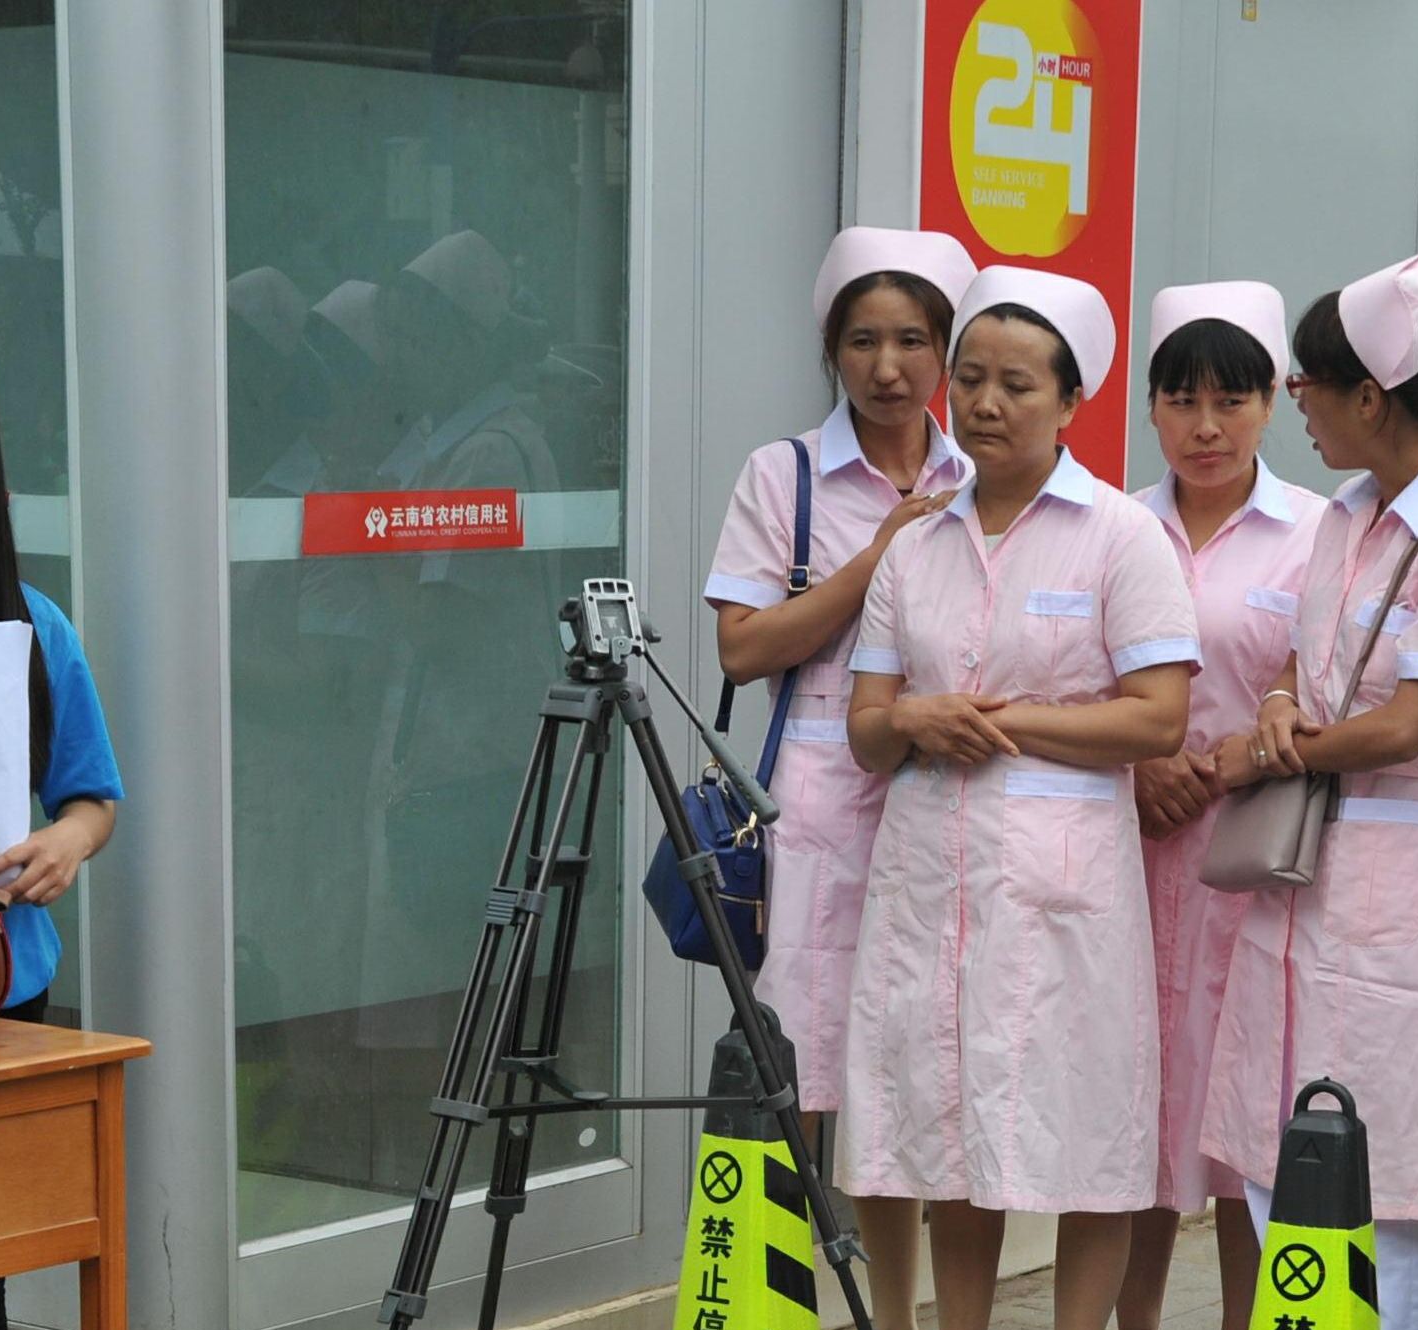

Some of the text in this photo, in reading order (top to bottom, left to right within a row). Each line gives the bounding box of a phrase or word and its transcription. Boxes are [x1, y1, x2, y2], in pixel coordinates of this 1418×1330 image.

[1037, 57, 1091, 78] 小时 HOUR
[974, 21, 1092, 215] 24
[972, 187, 1026, 208] BANKING
[390, 504, 508, 527] 云南省农村信用社
